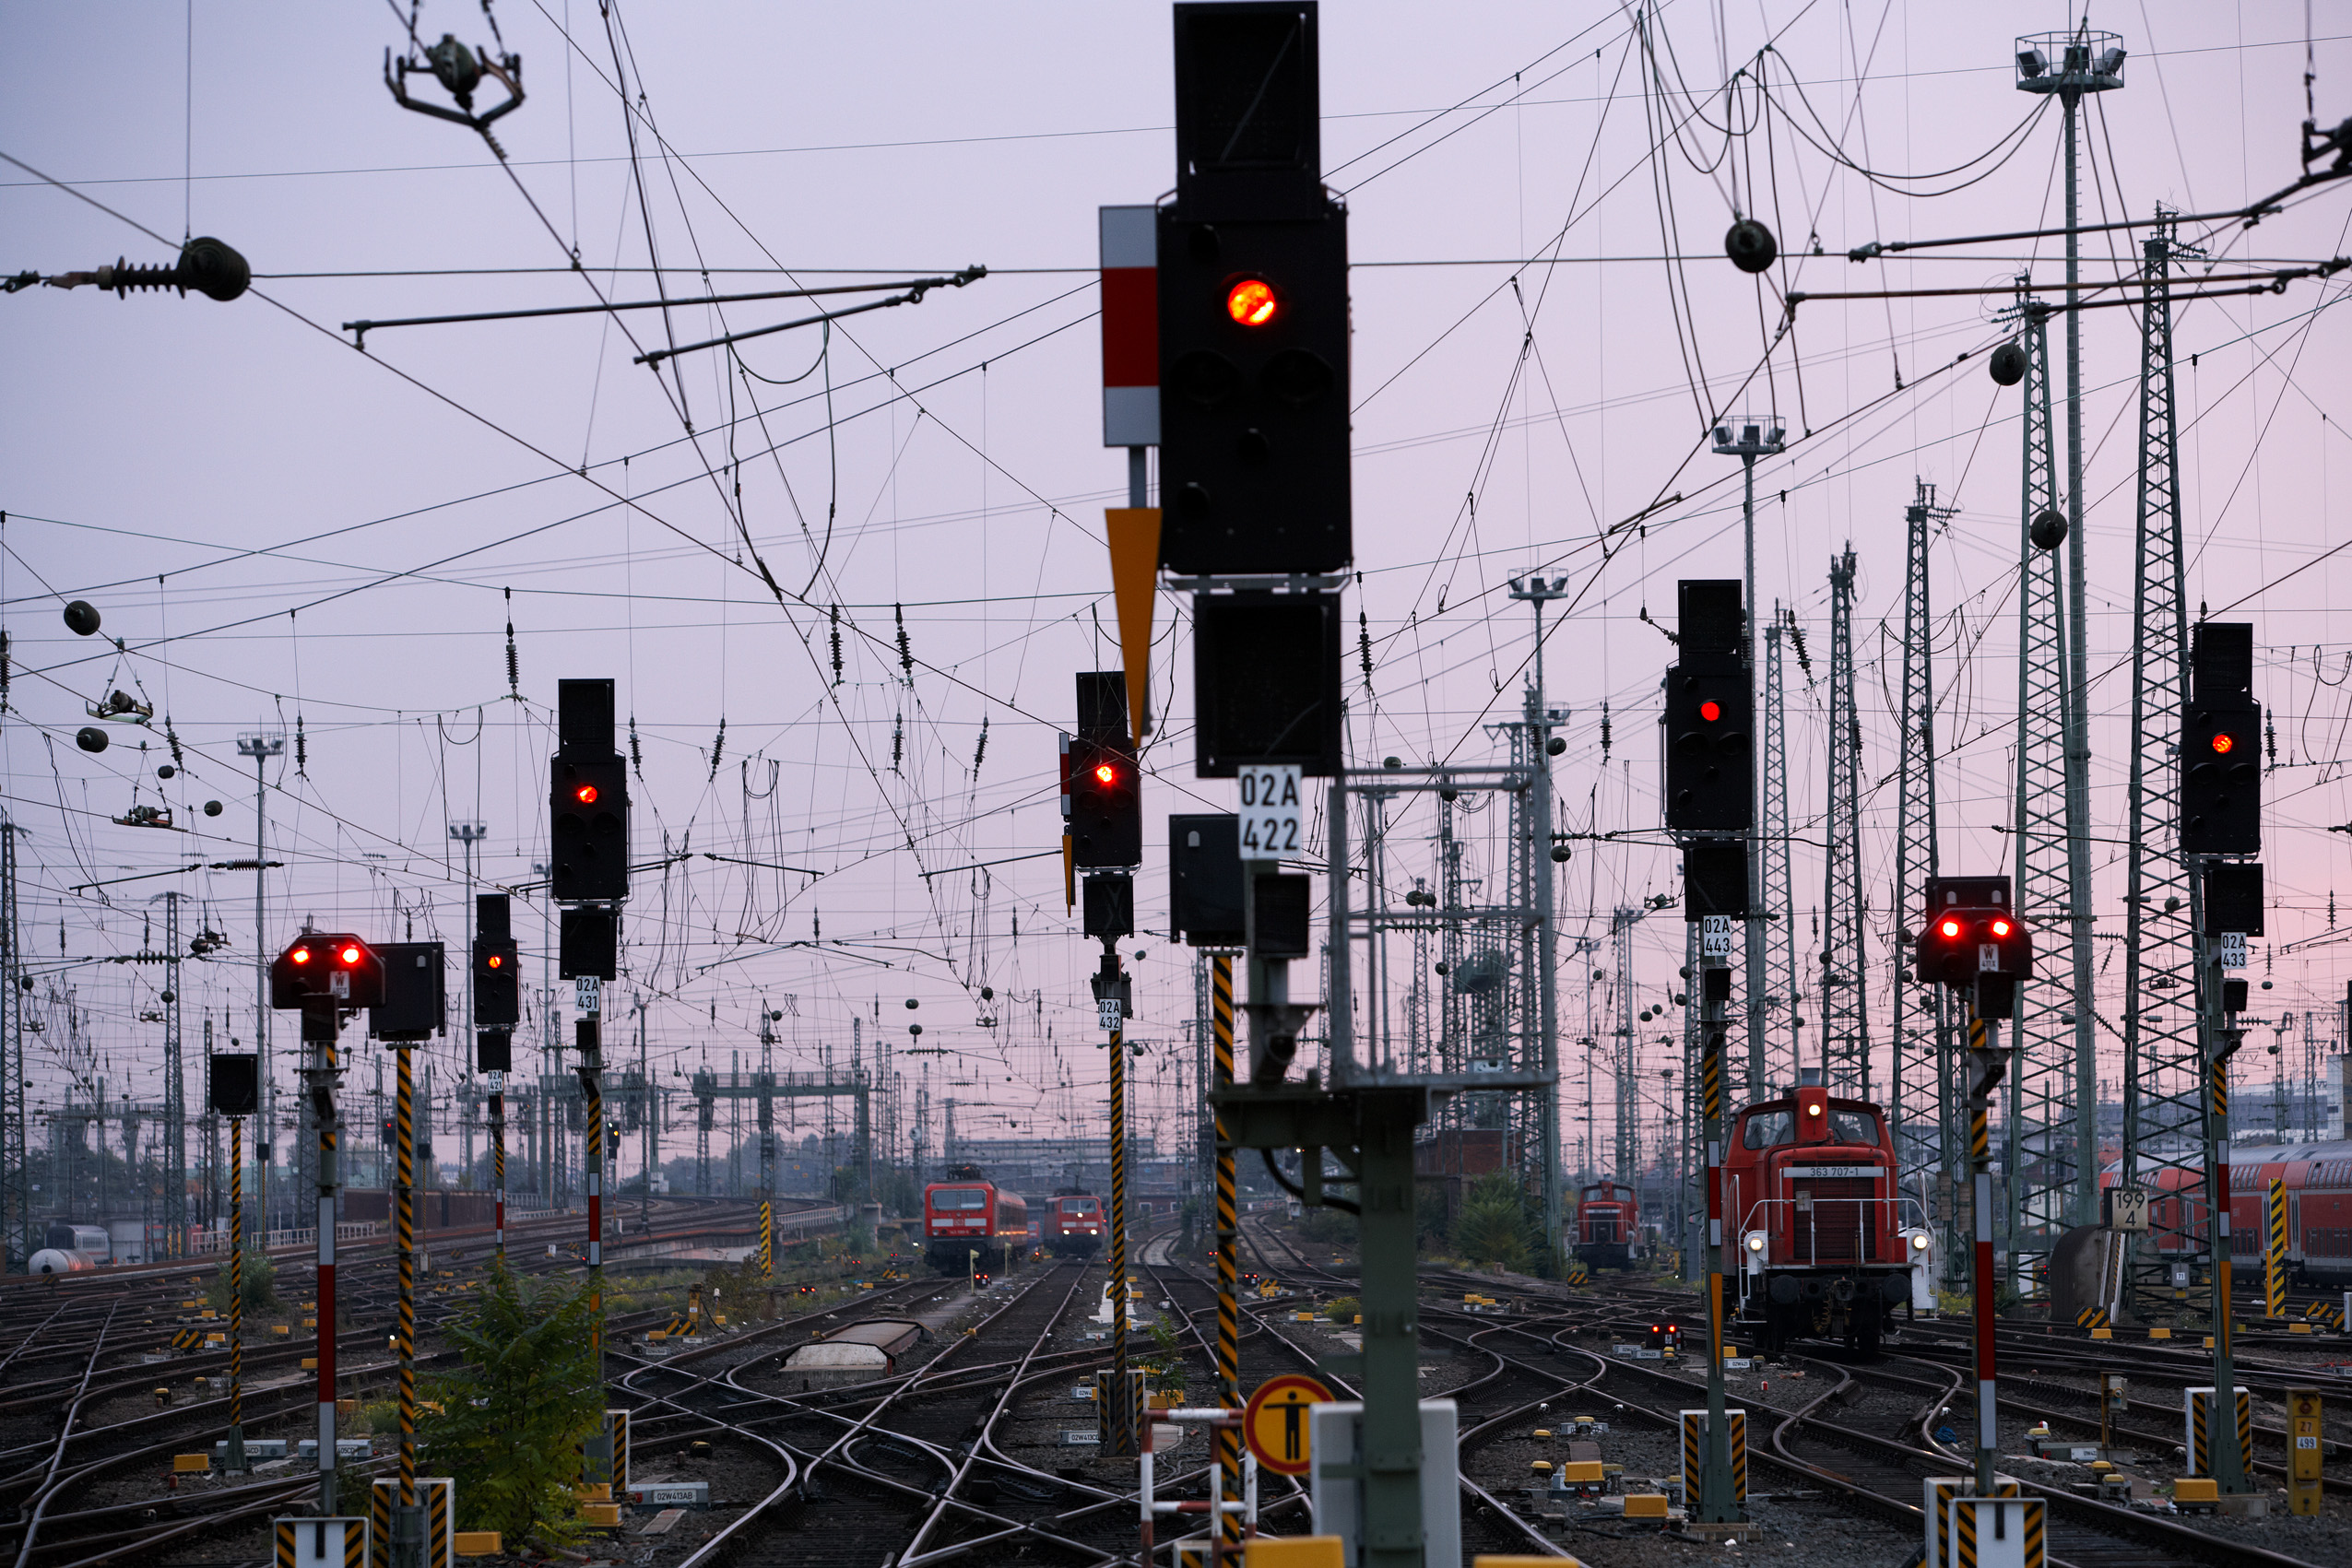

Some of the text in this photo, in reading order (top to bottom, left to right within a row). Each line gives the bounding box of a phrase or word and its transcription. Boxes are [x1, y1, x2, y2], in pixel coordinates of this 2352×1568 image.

[1242, 773, 1298, 807] 02A
[1243, 818, 1297, 851] 422
[1705, 918, 1731, 934] 02A
[1705, 937, 1730, 953] 443
[2222, 935, 2246, 949] 02A
[1983, 948, 1994, 960] W
[2223, 952, 2246, 967] 433
[335, 974, 345, 987] W
[576, 978, 599, 992] 02A
[577, 996, 597, 1009] 431
[1100, 1001, 1120, 1013] 02A
[1100, 1016, 1119, 1029] 432
[488, 1071, 502, 1079] 02A
[490, 1081, 502, 1090] 421
[1810, 1167, 1859, 1177] 363 707-1
[2116, 1193, 2145, 1209] 199
[2124, 1210, 2136, 1227] 4
[2299, 1438, 2315, 1448] 499
[656, 1491, 693, 1501] 02W413AB
